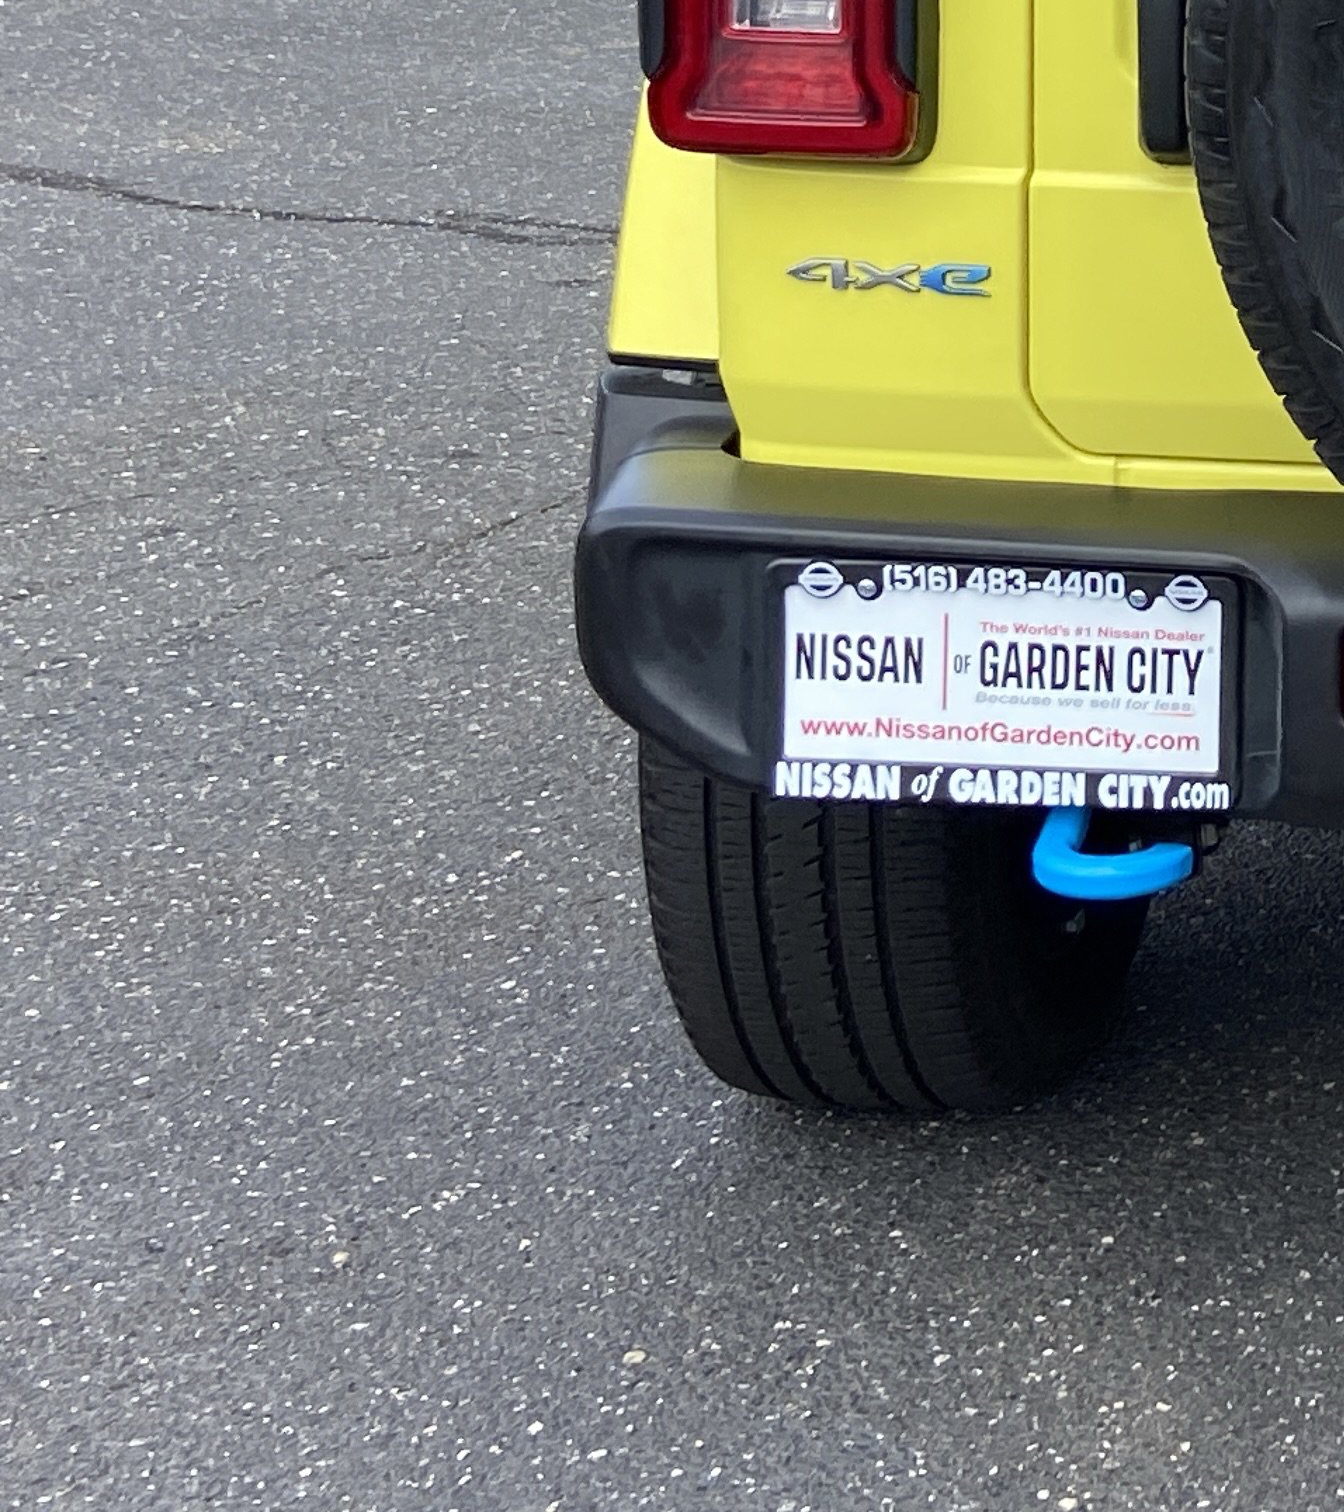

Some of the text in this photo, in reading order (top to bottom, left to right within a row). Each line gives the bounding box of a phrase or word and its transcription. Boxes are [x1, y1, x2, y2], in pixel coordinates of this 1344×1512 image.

[882, 564, 1125, 600] (516) 483-4400
[979, 621, 1206, 642] The World's #1 Nissan Dealer
[795, 632, 1205, 696] NISSAN OF GARDEN CITY
[975, 691, 1051, 707] Because
[1058, 697, 1083, 708] we
[1090, 697, 1120, 710] sell
[1125, 698, 1148, 711] for
[800, 717, 1200, 753] www.NissanofGardenCity.com
[774, 760, 1230, 810] NISSAN of GARDEN CITY.com
